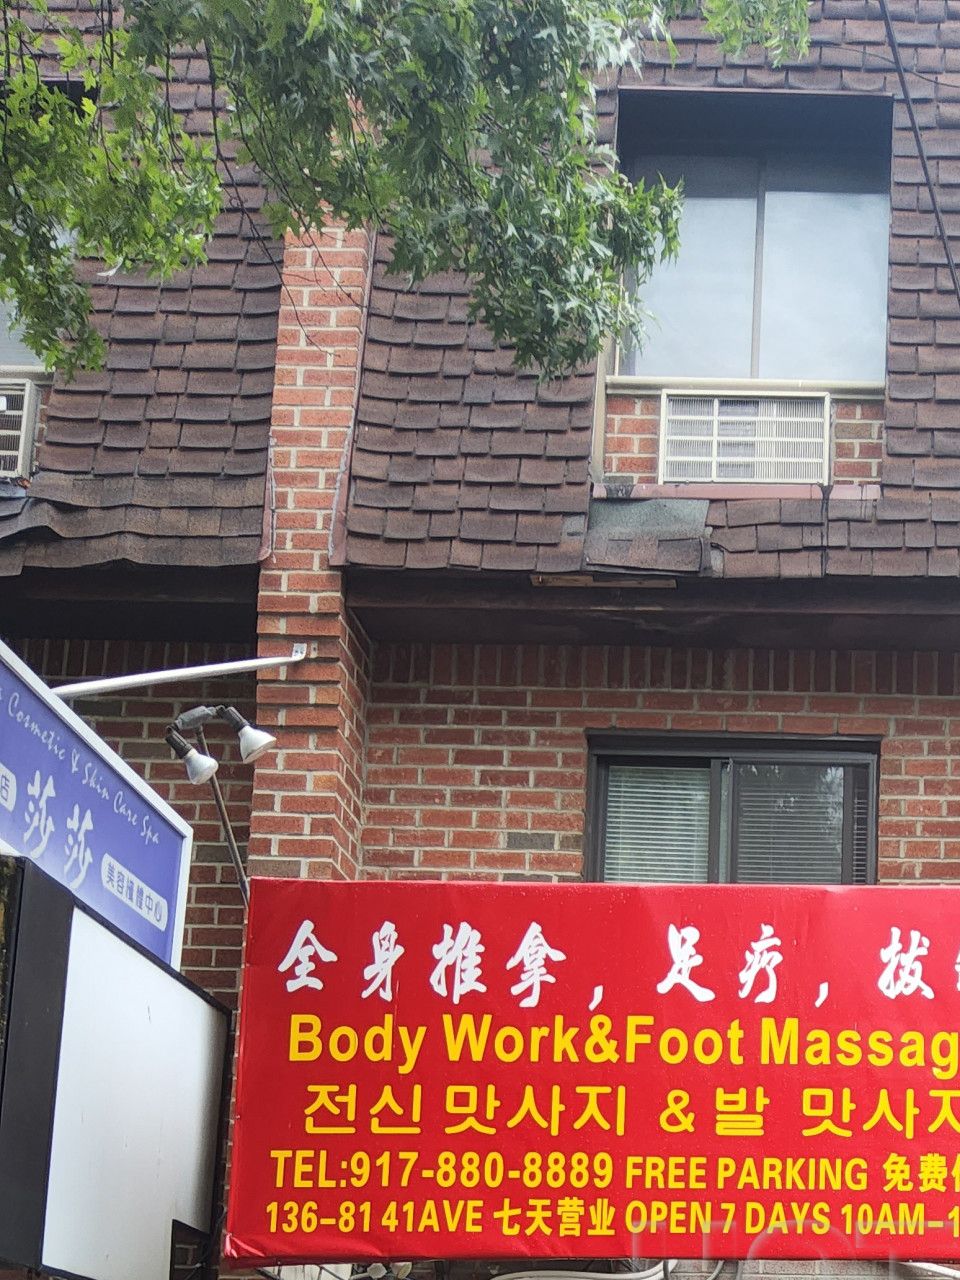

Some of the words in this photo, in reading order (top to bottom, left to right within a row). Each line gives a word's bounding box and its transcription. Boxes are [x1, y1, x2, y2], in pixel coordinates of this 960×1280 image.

[8, 692, 65, 760] Cosmetic
[82, 762, 109, 800] Skin
[113, 792, 137, 826] Care
[140, 816, 159, 845] Spa
[23, 770, 94, 889] 莎莎
[289, 1013, 427, 1074] Body
[659, 1089, 695, 1132] &
[715, 1086, 770, 1136] 발
[625, 1156, 707, 1190] FREE
[717, 1157, 868, 1191] PARKING
[494, 1197, 616, 1236] 七天营业
[625, 1201, 712, 1235] OPEN
[720, 1203, 736, 1234] 7
[745, 1202, 831, 1235] DAYS
